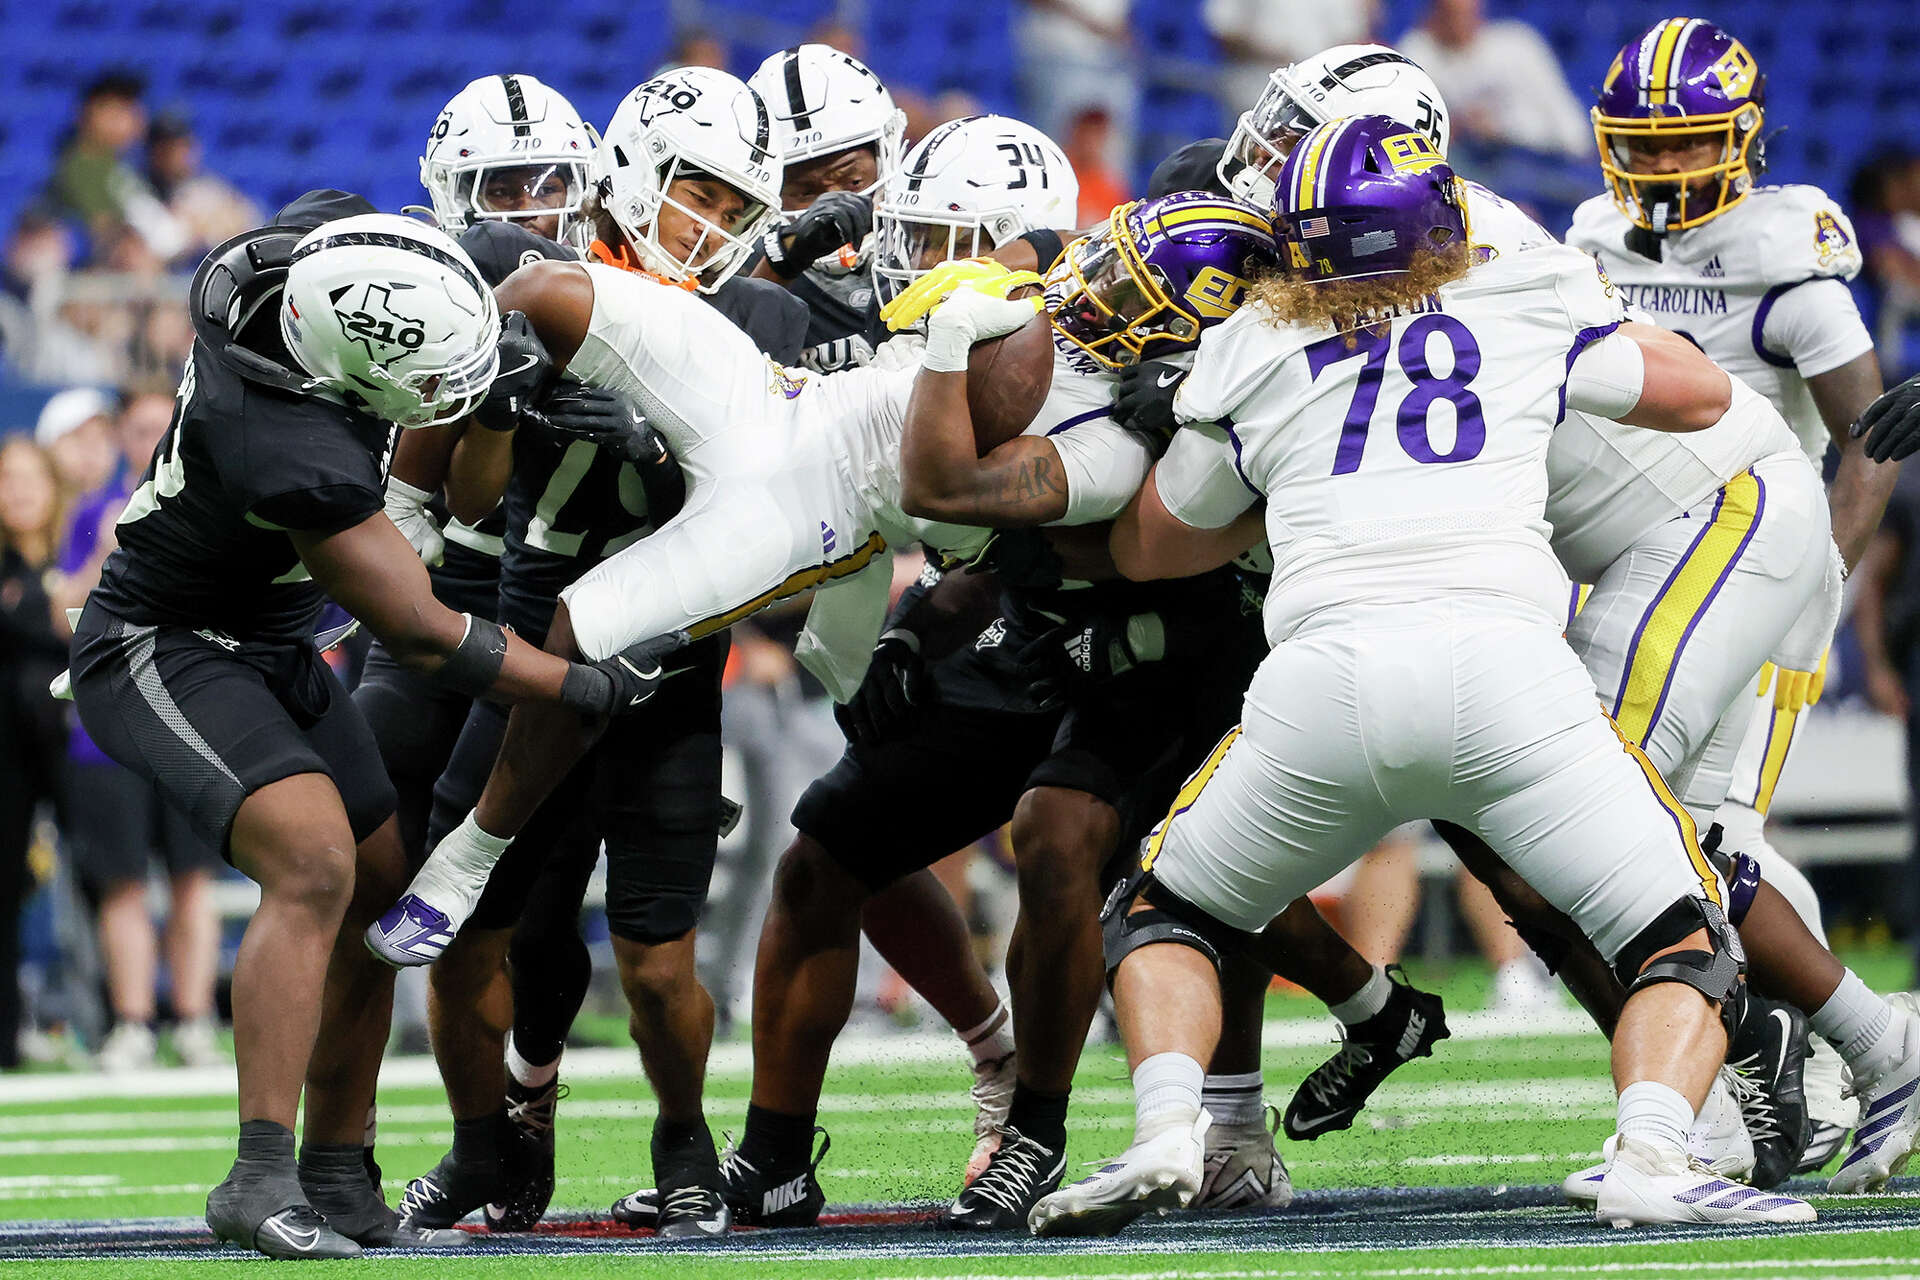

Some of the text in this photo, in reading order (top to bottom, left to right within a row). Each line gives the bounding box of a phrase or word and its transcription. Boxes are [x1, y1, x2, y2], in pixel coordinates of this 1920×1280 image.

[643, 80, 697, 109] 210
[1301, 80, 1326, 103] 210
[510, 137, 542, 151] 210
[791, 130, 823, 148] 210
[744, 163, 771, 184] 210
[996, 143, 1048, 189] 34
[896, 193, 920, 206] 210
[1316, 258, 1334, 275] 78
[1640, 284, 1728, 315] CAROLINA
[347, 311, 426, 349] 210
[1303, 312, 1487, 477] 78
[1082, 627, 1094, 672] adidas
[1395, 1008, 1427, 1060] NIKE
[761, 1172, 808, 1217] NIKE
